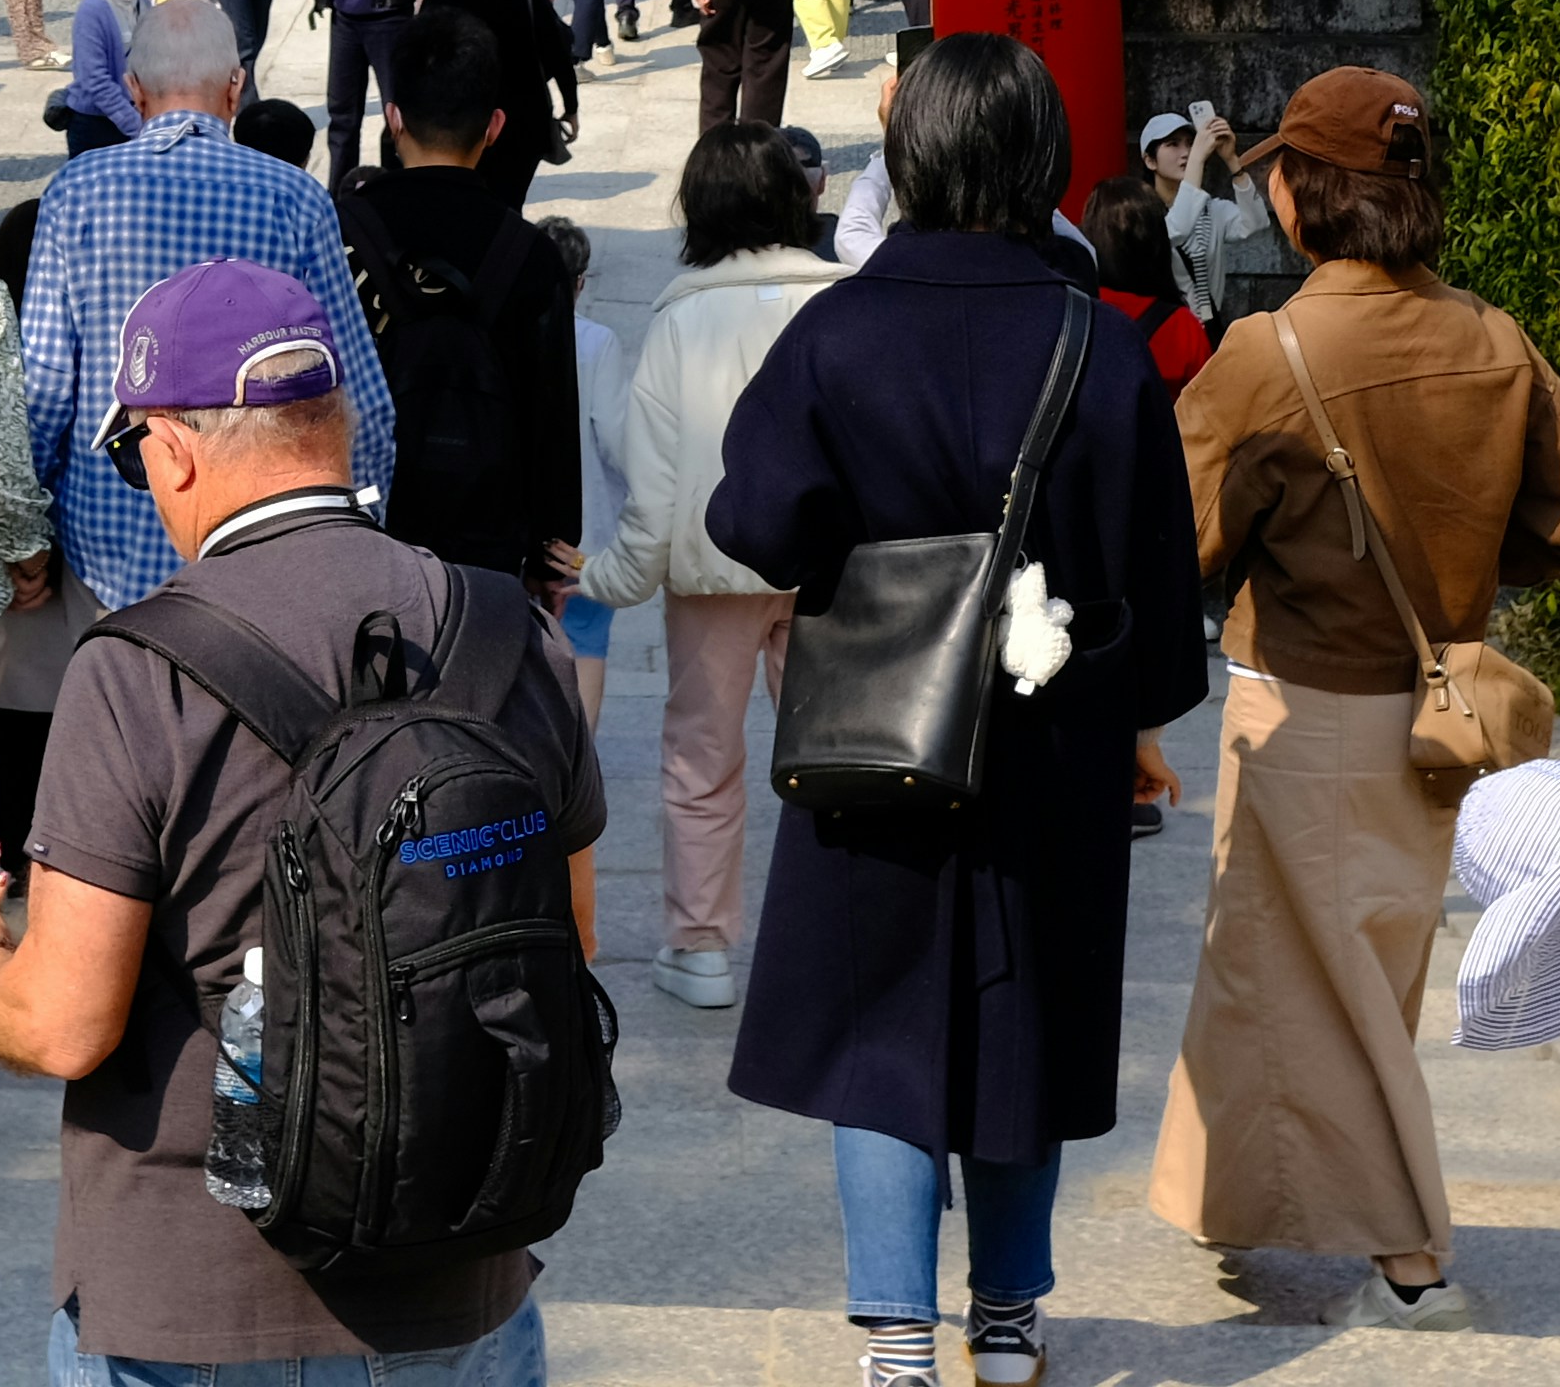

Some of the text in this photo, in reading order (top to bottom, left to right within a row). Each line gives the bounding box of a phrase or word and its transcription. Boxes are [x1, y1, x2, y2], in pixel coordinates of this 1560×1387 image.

[237, 327, 288, 356] HARBOUR
[399, 810, 547, 864] SCENIC CLUB
[445, 847, 523, 878] DIAMOND
